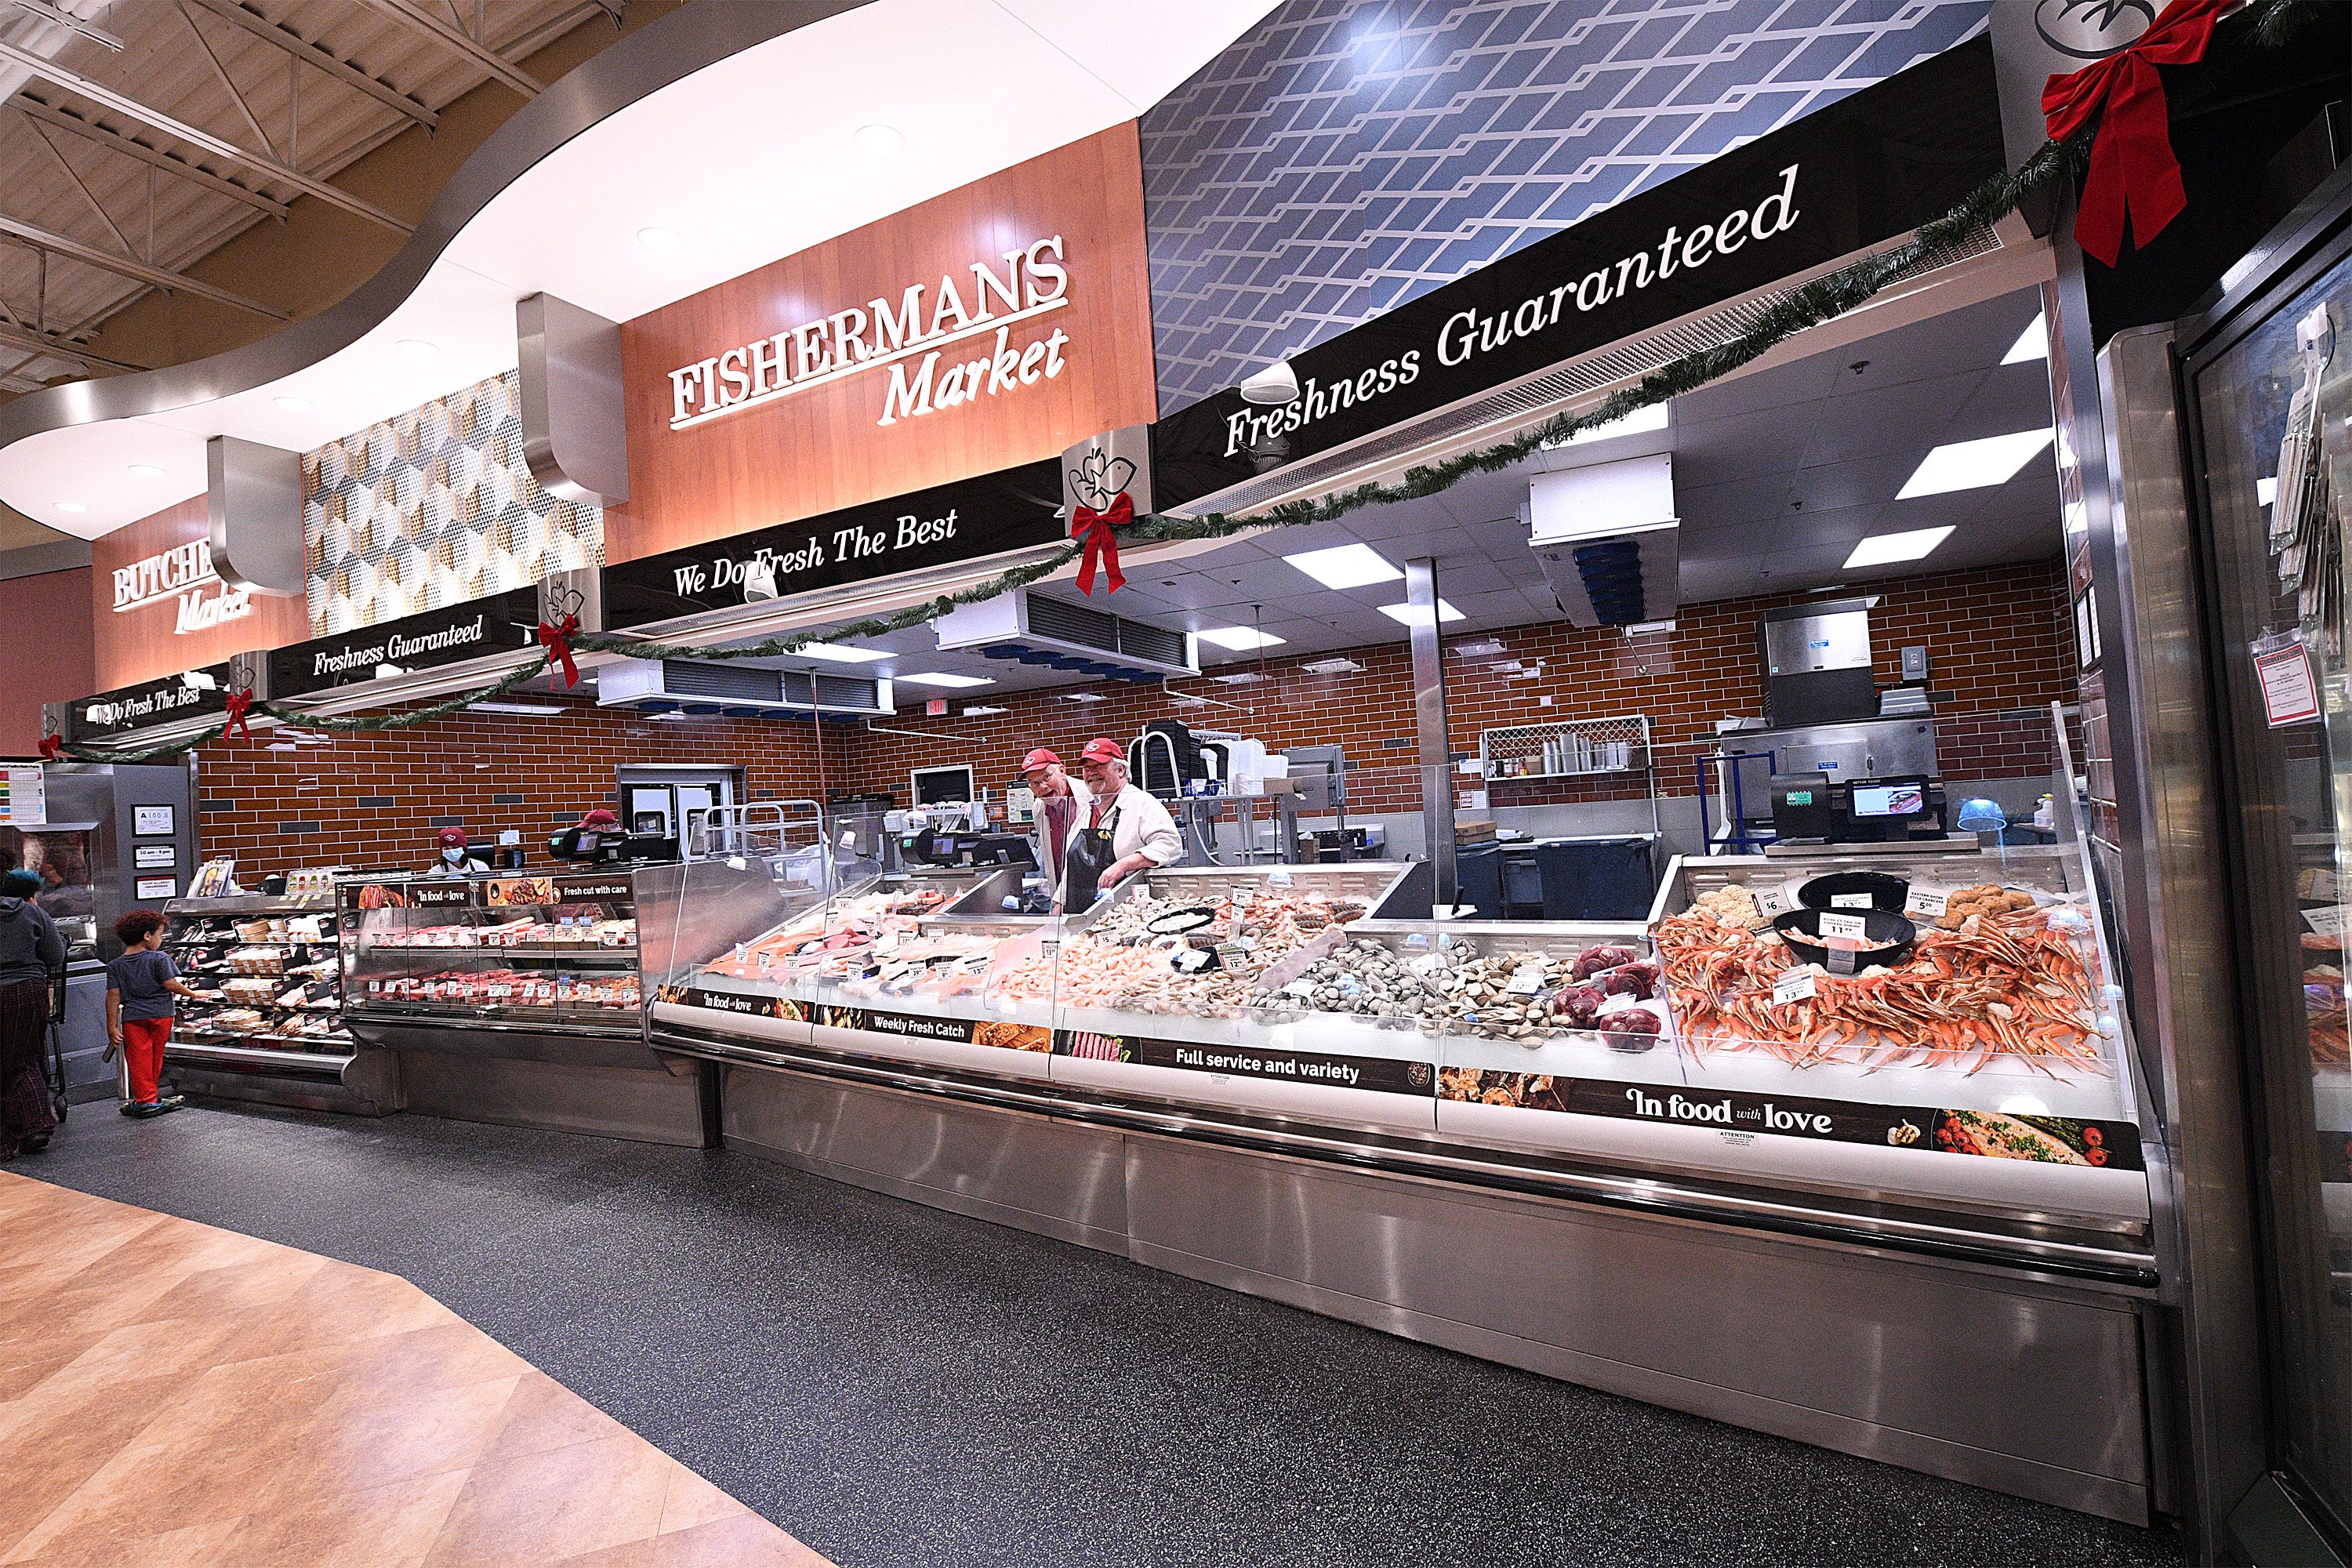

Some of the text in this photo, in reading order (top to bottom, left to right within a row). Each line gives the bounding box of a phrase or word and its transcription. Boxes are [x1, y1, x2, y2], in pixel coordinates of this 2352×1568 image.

[667, 234, 1069, 424] FISHERMANS
[1222, 162, 1802, 458] Freshness Guaranteed
[877, 325, 1069, 427] Market
[112, 536, 216, 608] BUTCHE
[673, 509, 958, 597] We Do Fresh The Best
[173, 580, 252, 635] Market
[313, 614, 484, 676] Freshness Guaranteed
[111, 702, 124, 720] Do
[125, 695, 153, 718] Fresh
[154, 690, 176, 711] The
[177, 685, 201, 706] Best
[929, 699, 944, 714] EXIT
[417, 890, 465, 902] In food love
[564, 887, 582, 895] Fresh
[583, 886, 594, 895] cut
[595, 885, 610, 894] with
[703, 992, 752, 1011] In food love
[873, 1015, 965, 1038] Weekly Fresh Catch
[1176, 1048, 1360, 1085] Full service and variety
[1625, 1087, 1833, 1134] In food with love
